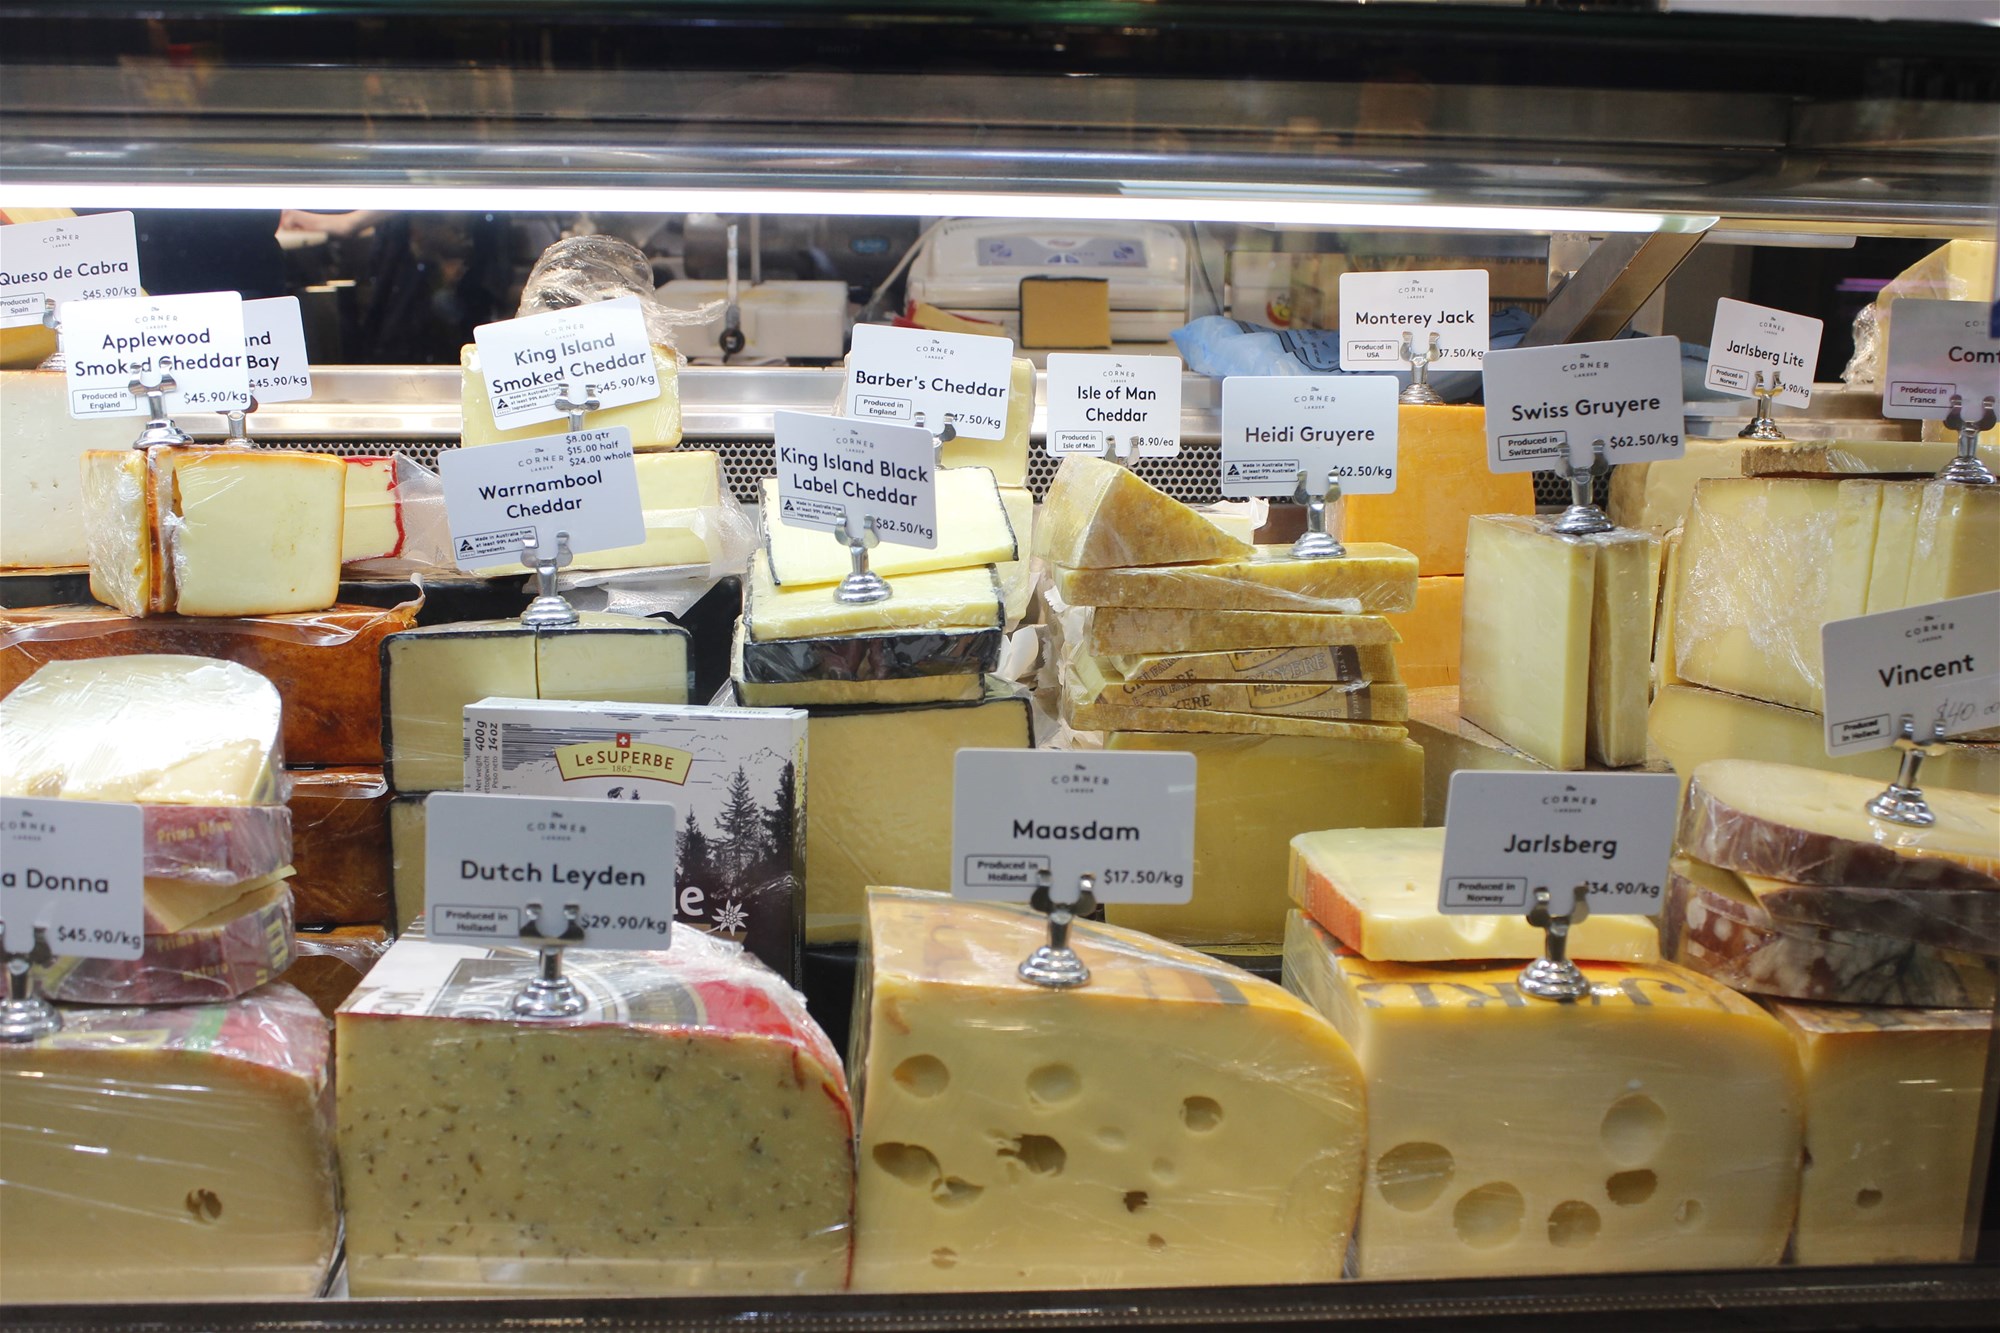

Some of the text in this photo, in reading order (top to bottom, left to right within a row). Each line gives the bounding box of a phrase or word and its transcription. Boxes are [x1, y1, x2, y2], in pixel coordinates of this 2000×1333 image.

[43, 235, 79, 243] CORNER
[0, 261, 128, 286] Queso de Cabra
[83, 287, 136, 300] $45.90/kg
[135, 315, 178, 324] CORNER
[1356, 310, 1475, 328] Monterey Jack
[544, 324, 585, 336] CORNER
[1760, 322, 1785, 332] CORNER
[102, 328, 210, 352] Applewood
[514, 333, 615, 366] King Island
[916, 346, 955, 355] CORNER
[1727, 340, 1804, 367] Jarlsberg Lite
[247, 356, 279, 371] Bay
[1562, 362, 1609, 372] CORNER
[492, 352, 646, 394] Smoked Cheddar
[1716, 370, 1738, 378] Produced
[856, 371, 1006, 397] Barber's Cheddar
[1720, 378, 1737, 386] Norway
[82, 393, 118, 401] Produced
[184, 391, 247, 404] $45.90/kg
[1078, 386, 1156, 400] Isle of Man
[1294, 395, 1336, 403] CORNER
[90, 401, 120, 410] England
[863, 399, 896, 407] Produced
[1512, 398, 1660, 421] Swiss Gruyere
[869, 408, 897, 416] England
[1086, 408, 1147, 422] Cheddar
[566, 432, 610, 444] $8.00 qtr
[836, 438, 874, 448] CORNER
[1245, 426, 1375, 446] Heidi Gruyere
[1508, 438, 1547, 446] Produced
[1610, 433, 1678, 449] $62.50/kg
[567, 441, 619, 455] $15.00 half
[518, 455, 564, 467] CORNER
[569, 451, 632, 467] $24.00 whole
[781, 447, 928, 483] King Island Black
[1333, 466, 1392, 478] 62.50/kg
[479, 470, 603, 500] Warrnambool
[794, 474, 917, 507] Label Cheddar
[506, 498, 582, 519] Cheddar
[876, 519, 933, 539] $82.50/kg
[1905, 623, 1954, 637] CORNER
[1878, 655, 1974, 687] Vincent
[475, 721, 487, 751] 400g
[488, 723, 498, 751] 14oz
[576, 751, 674, 770] Le SUPERBE
[1052, 776, 1110, 785] CORNER
[1542, 795, 1597, 805] CORNER
[527, 823, 586, 834] CORNER
[1013, 820, 1140, 841] Maasdam
[1504, 834, 1617, 859] Jarlsberg
[978, 861, 1038, 870] Produced in
[27, 869, 109, 893] Donna
[461, 860, 645, 890] Dutch Leyden
[988, 873, 1027, 882] Holland
[1104, 870, 1183, 887] $17.50/kg
[1458, 883, 1503, 891] Produced
[1586, 881, 1660, 897] 34.90/kg
[446, 911, 508, 920] Produced in
[457, 923, 497, 932] Holland
[581, 915, 667, 934] $29.90/kg
[58, 926, 141, 950] $45.90/kg
